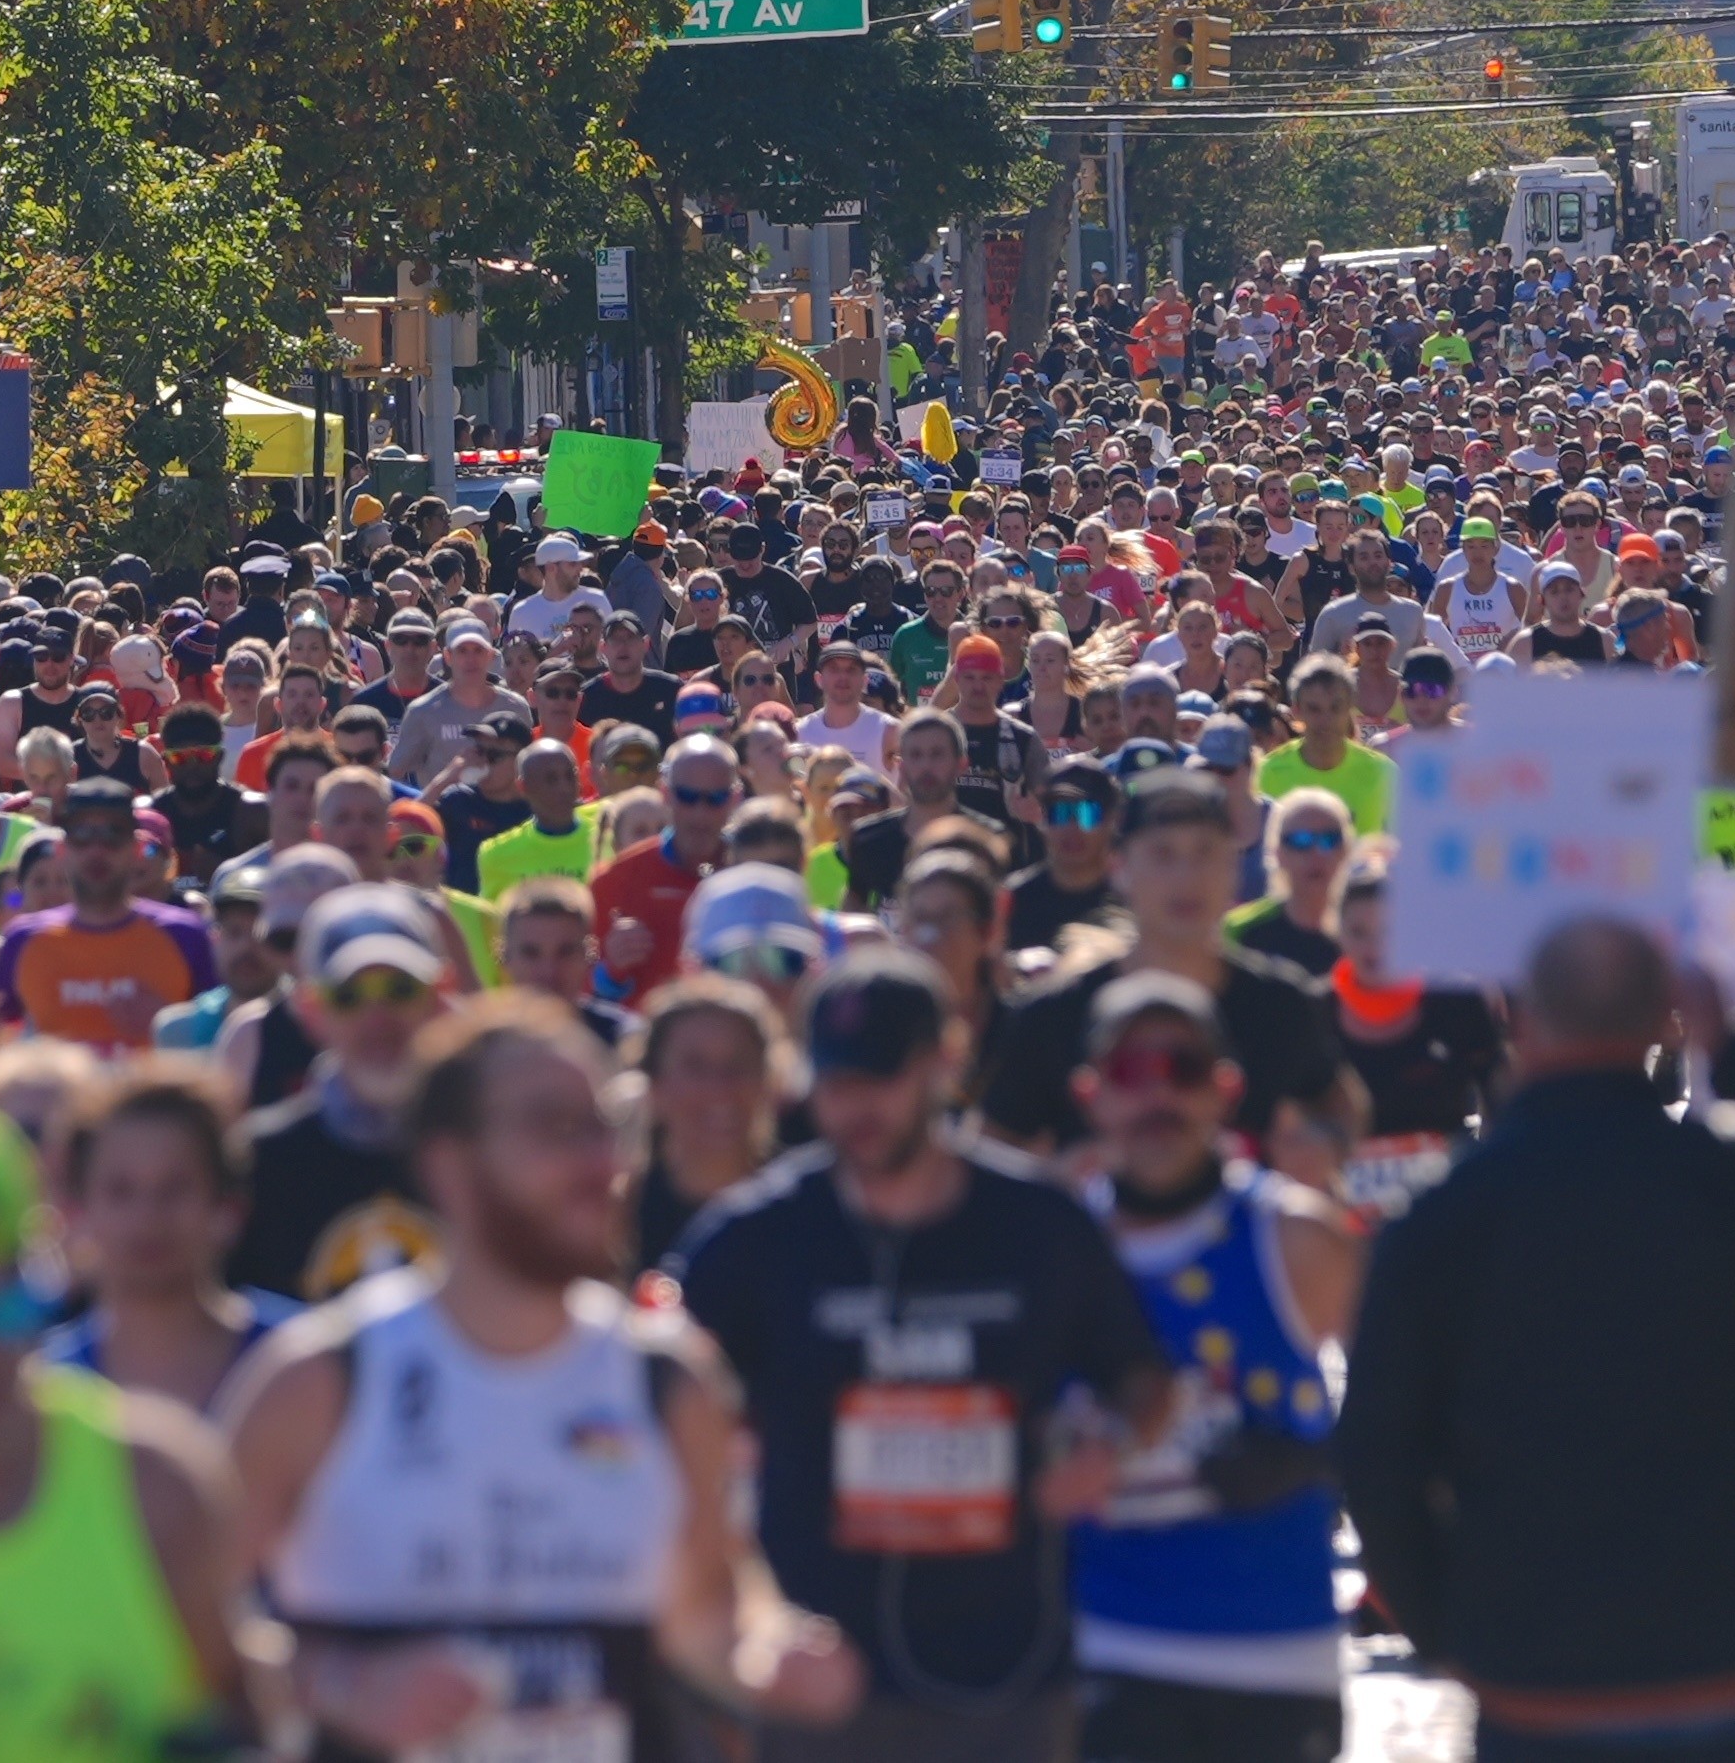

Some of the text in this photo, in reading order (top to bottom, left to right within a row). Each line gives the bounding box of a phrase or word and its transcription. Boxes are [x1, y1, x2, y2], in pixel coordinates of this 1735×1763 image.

[687, 0, 734, 32] 47
[872, 507, 900, 520] 3:45
[1464, 599, 1494, 610] KRIS
